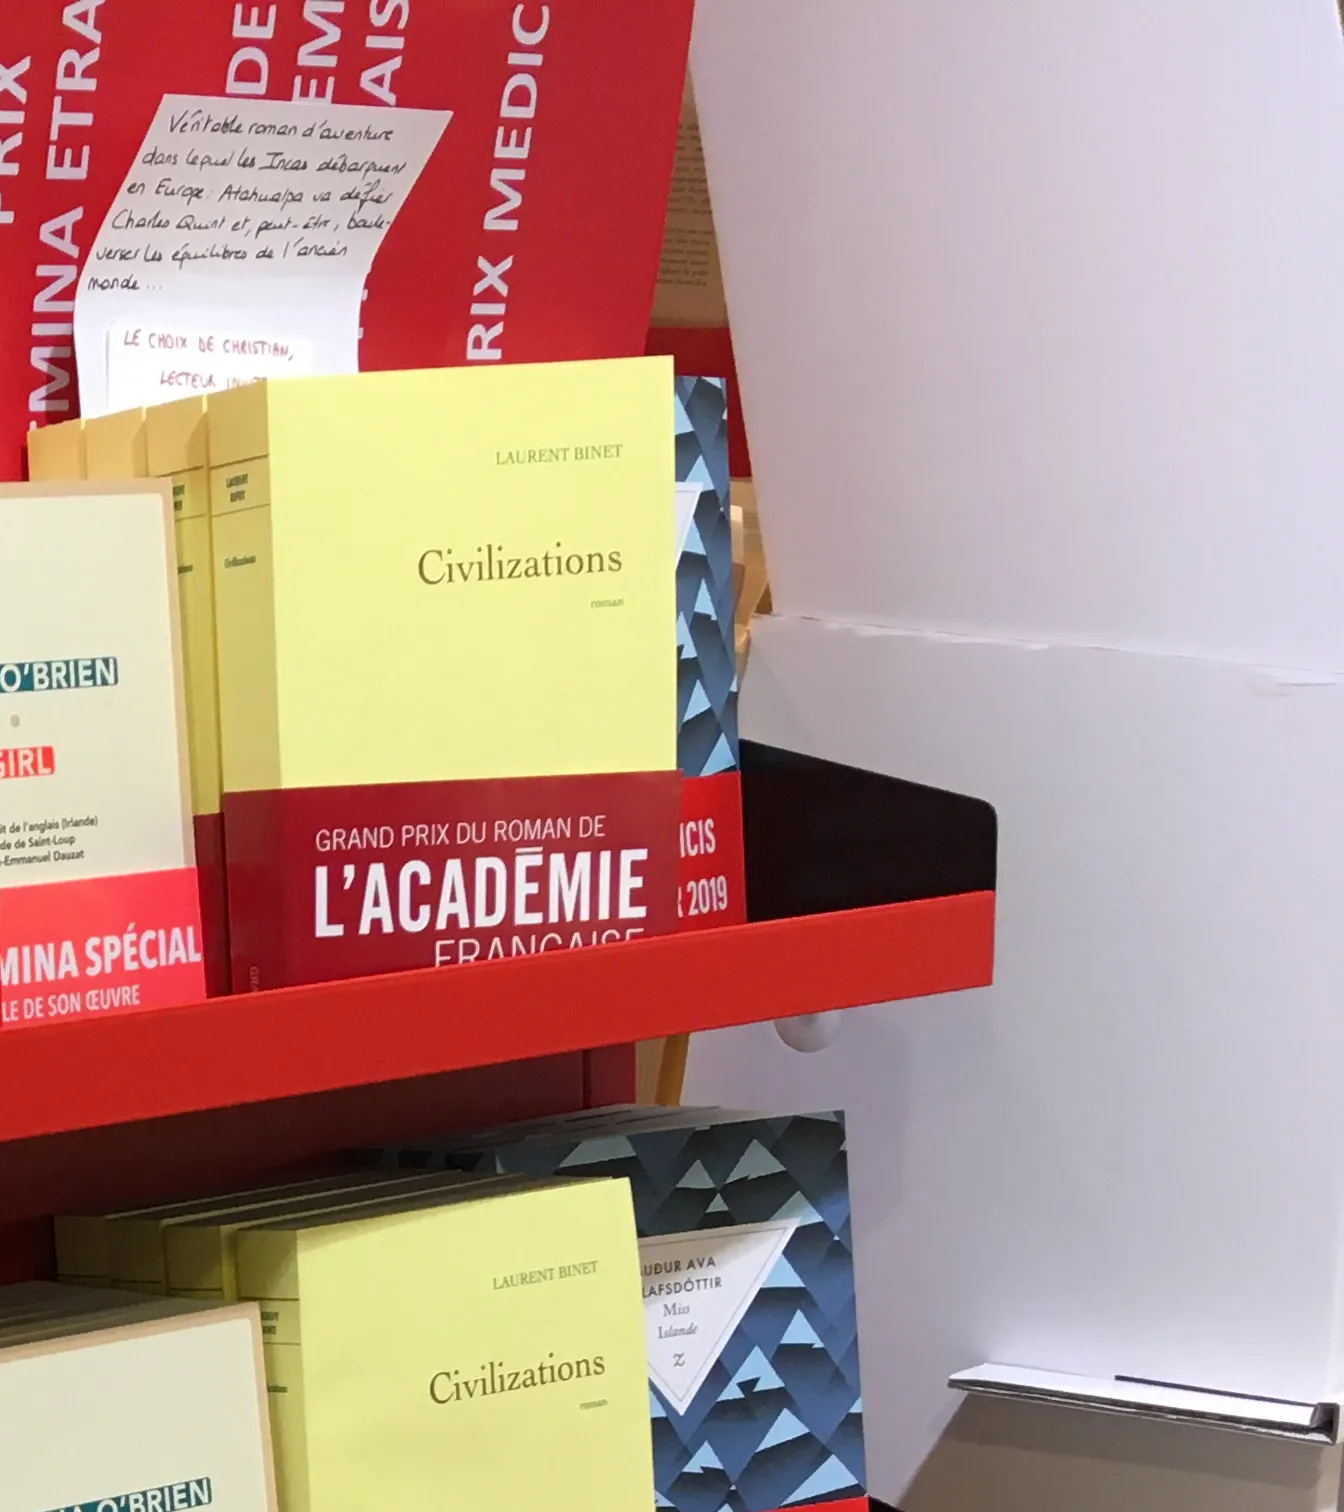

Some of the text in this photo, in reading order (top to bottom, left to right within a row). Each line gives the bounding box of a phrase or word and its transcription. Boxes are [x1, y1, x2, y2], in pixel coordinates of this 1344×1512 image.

[225, 3, 277, 96] DE
[124, 328, 142, 346] LE
[148, 333, 188, 349] CHOIX
[199, 336, 214, 353] DE
[496, 443, 623, 466] LAURENT BINET
[417, 542, 623, 586] Civilizations
[0, 657, 117, 691] O'BRIEN
[315, 815, 607, 852] GRAND PRIX DU ROMAN DE
[314, 845, 648, 939] L'ACADÉMIE
[687, 875, 729, 917] 2019
[85, 923, 202, 977] SPÉCIAL
[23, 984, 140, 1020] DE SON ŒUVRE
[492, 1260, 598, 1291] LAURENT BINET
[686, 1256, 717, 1272] AVA
[662, 1301, 691, 1319] Miss
[657, 1320, 698, 1340] Islande
[429, 1352, 606, 1406] Civilizations
